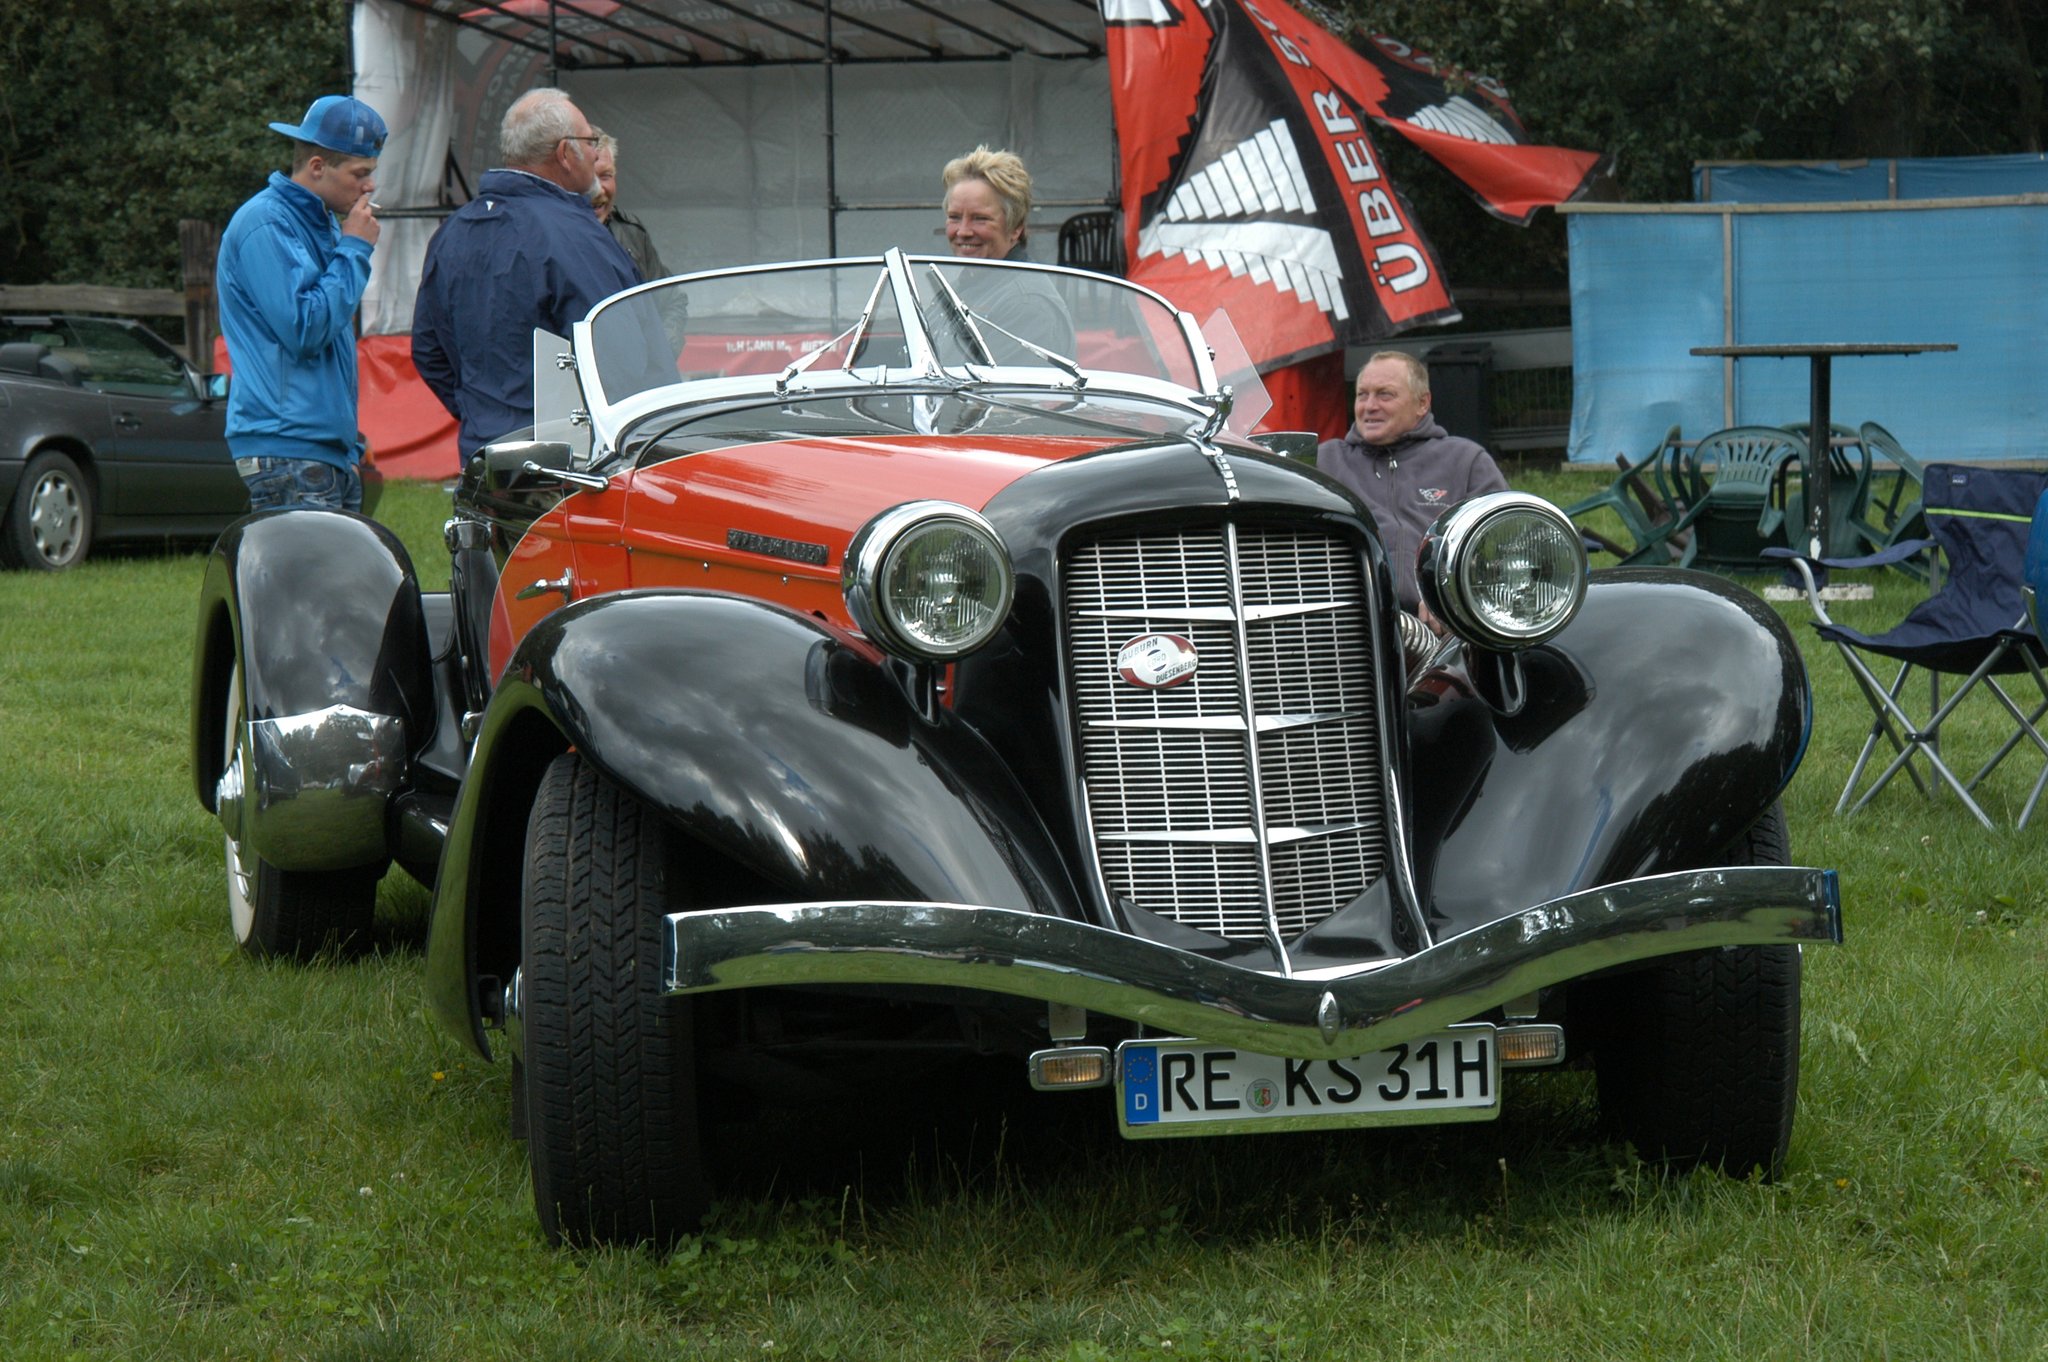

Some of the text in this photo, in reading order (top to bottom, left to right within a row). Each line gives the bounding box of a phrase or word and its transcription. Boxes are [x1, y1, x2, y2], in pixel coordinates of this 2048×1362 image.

[1312, 90, 1430, 294] ÜBER
[1121, 637, 1158, 662] AUBURN
[1155, 658, 1197, 683] DUESENBERG
[1161, 1051, 1240, 1112] RE
[1377, 1039, 1489, 1101] 31H
[1135, 1093, 1148, 1110] D
